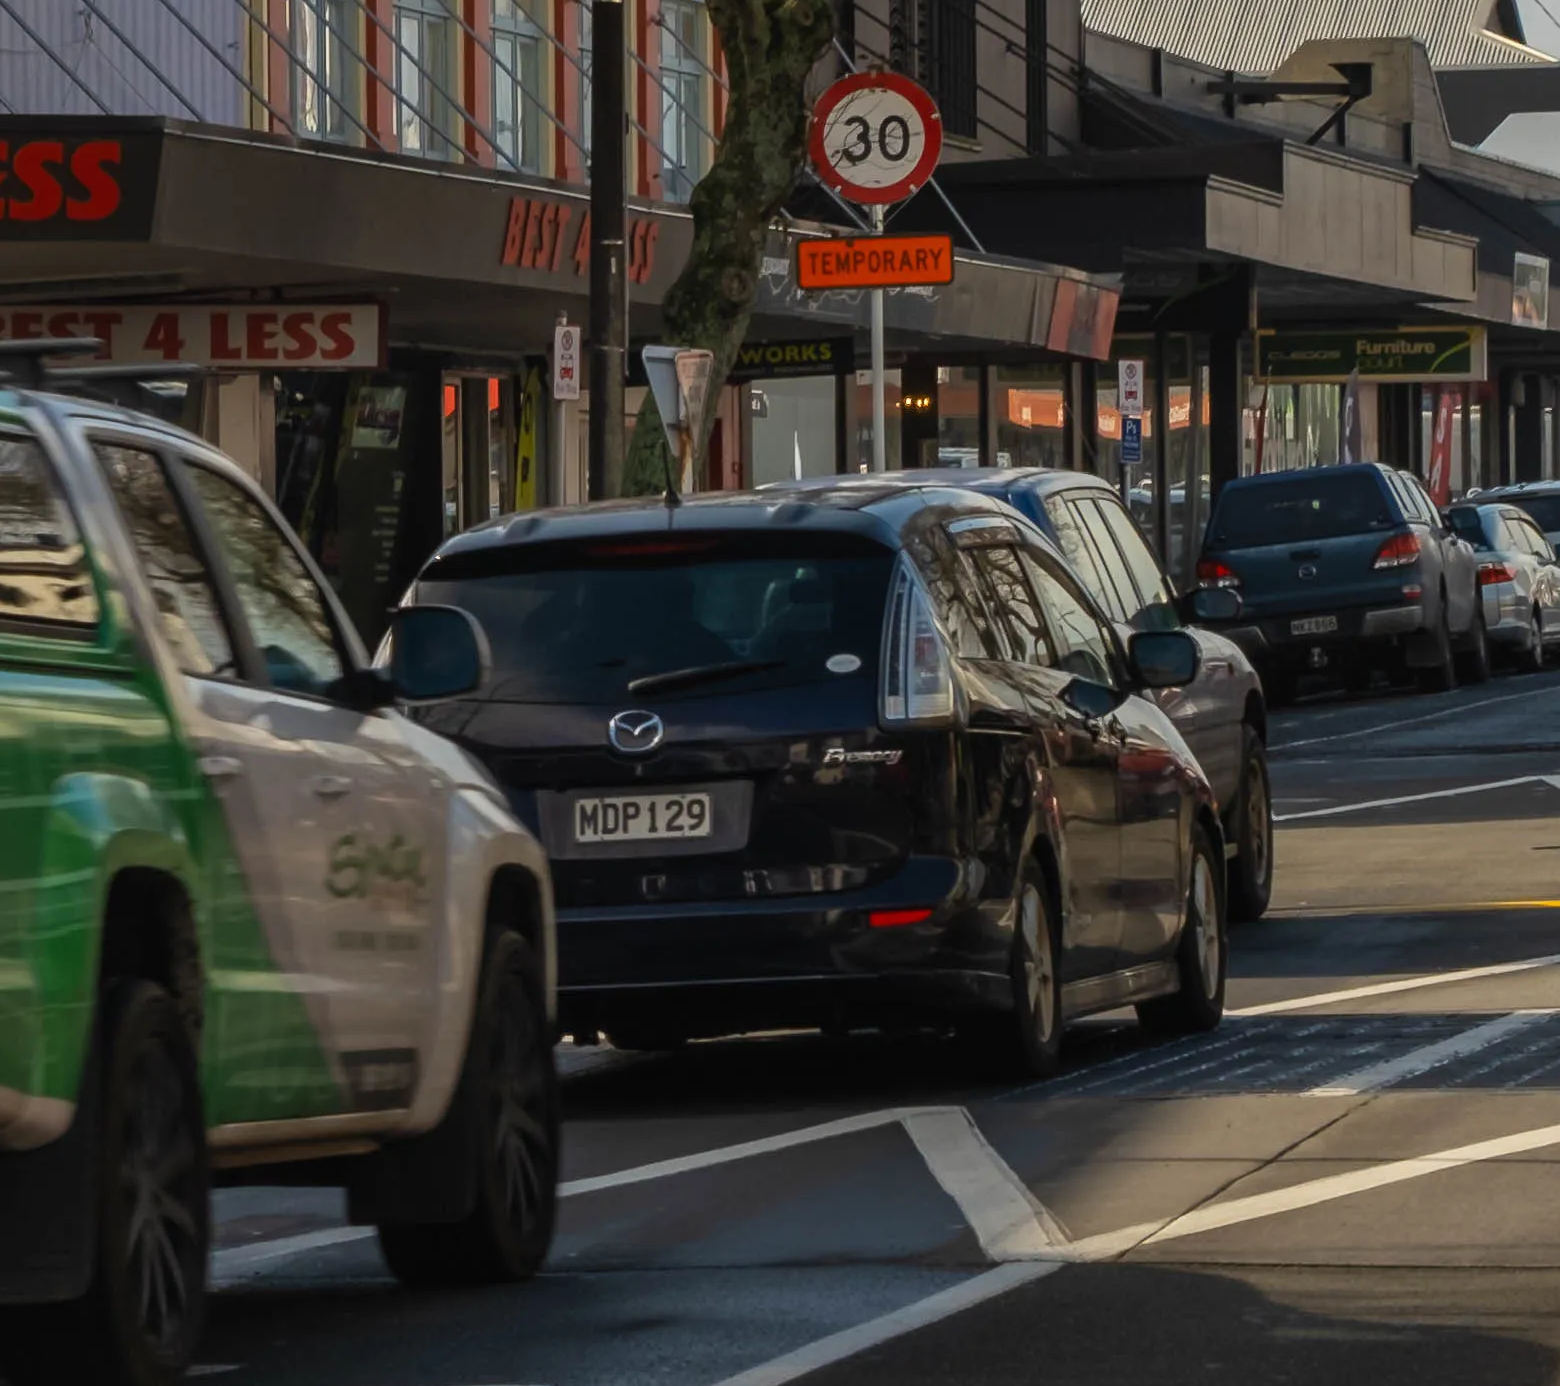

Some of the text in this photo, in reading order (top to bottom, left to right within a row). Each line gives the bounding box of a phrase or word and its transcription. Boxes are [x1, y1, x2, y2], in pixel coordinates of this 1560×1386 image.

[842, 114, 911, 163] 30
[501, 195, 572, 273] BEST
[808, 246, 944, 276] TEMPORARY
[143, 312, 186, 361] 4
[210, 312, 356, 361] LESS
[1355, 339, 1436, 355] Furniture
[579, 797, 708, 838] MDP129
